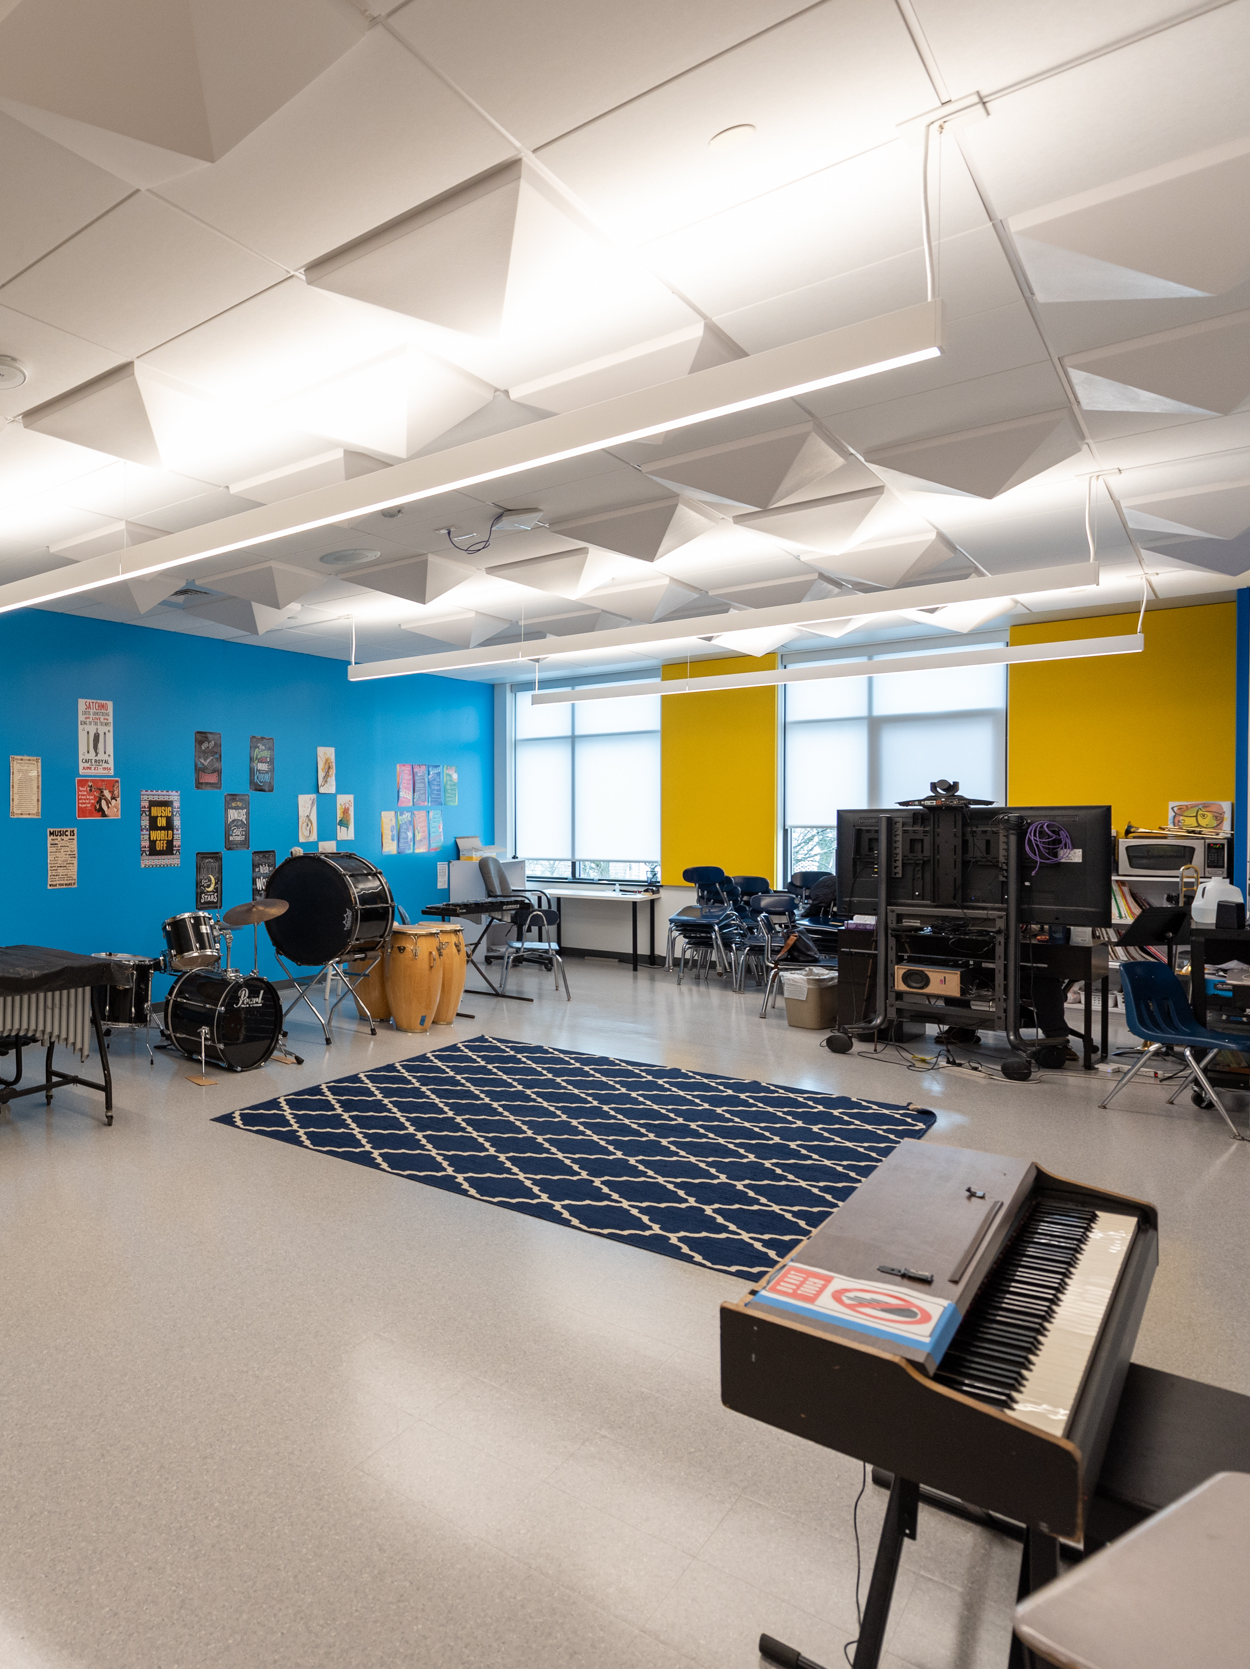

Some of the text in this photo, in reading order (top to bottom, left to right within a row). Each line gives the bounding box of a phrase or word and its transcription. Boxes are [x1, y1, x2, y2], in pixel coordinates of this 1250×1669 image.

[84, 701, 108, 711] SATCHMO
[151, 806, 172, 817] MUSIC
[157, 817, 166, 827] ON
[150, 830, 173, 840] WORLD
[156, 840, 167, 851] OFF
[201, 893, 218, 903] STARS
[234, 988, 264, 1008] Pearl
[776, 1270, 807, 1293] DO NOT
[796, 1277, 825, 1297] TOUCH
